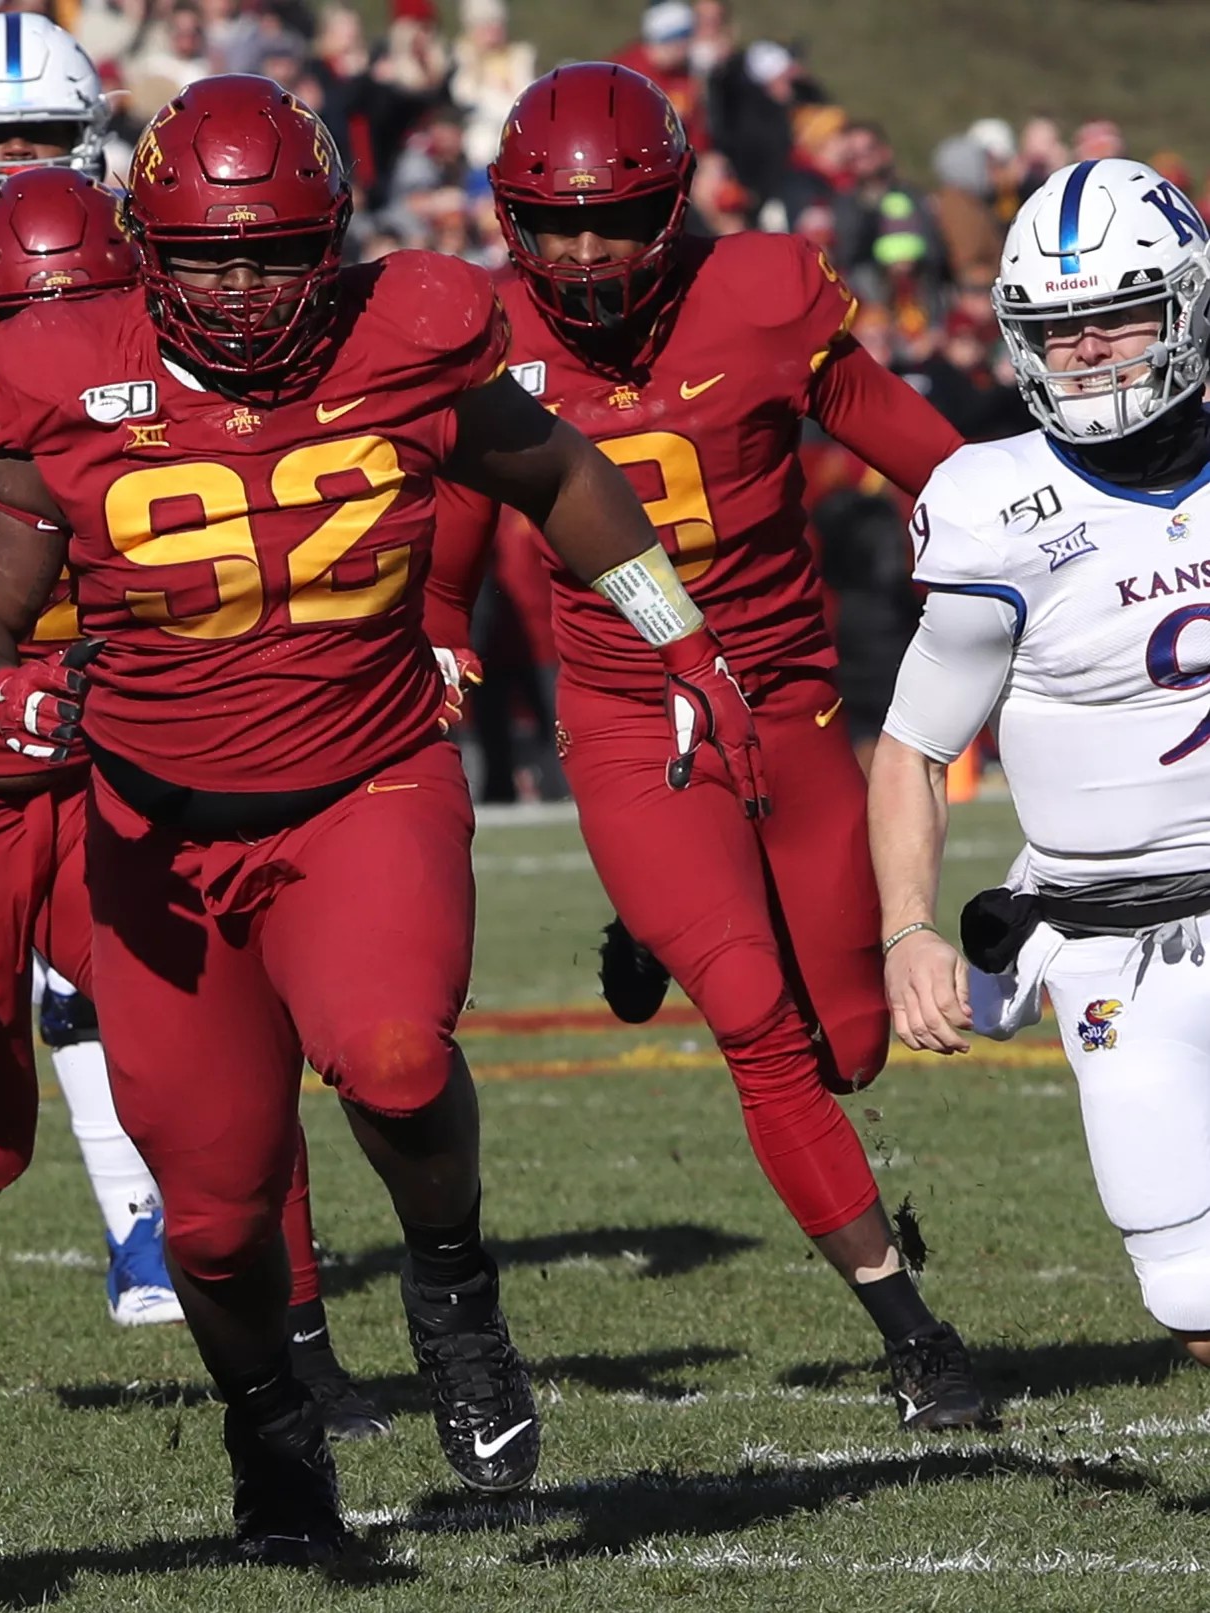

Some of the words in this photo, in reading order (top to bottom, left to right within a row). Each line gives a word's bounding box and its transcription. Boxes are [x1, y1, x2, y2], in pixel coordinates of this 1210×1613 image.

[1045, 276, 1099, 294] Riddell
[87, 382, 155, 421] 150
[999, 484, 1062, 534] 150
[105, 435, 411, 639] 92
